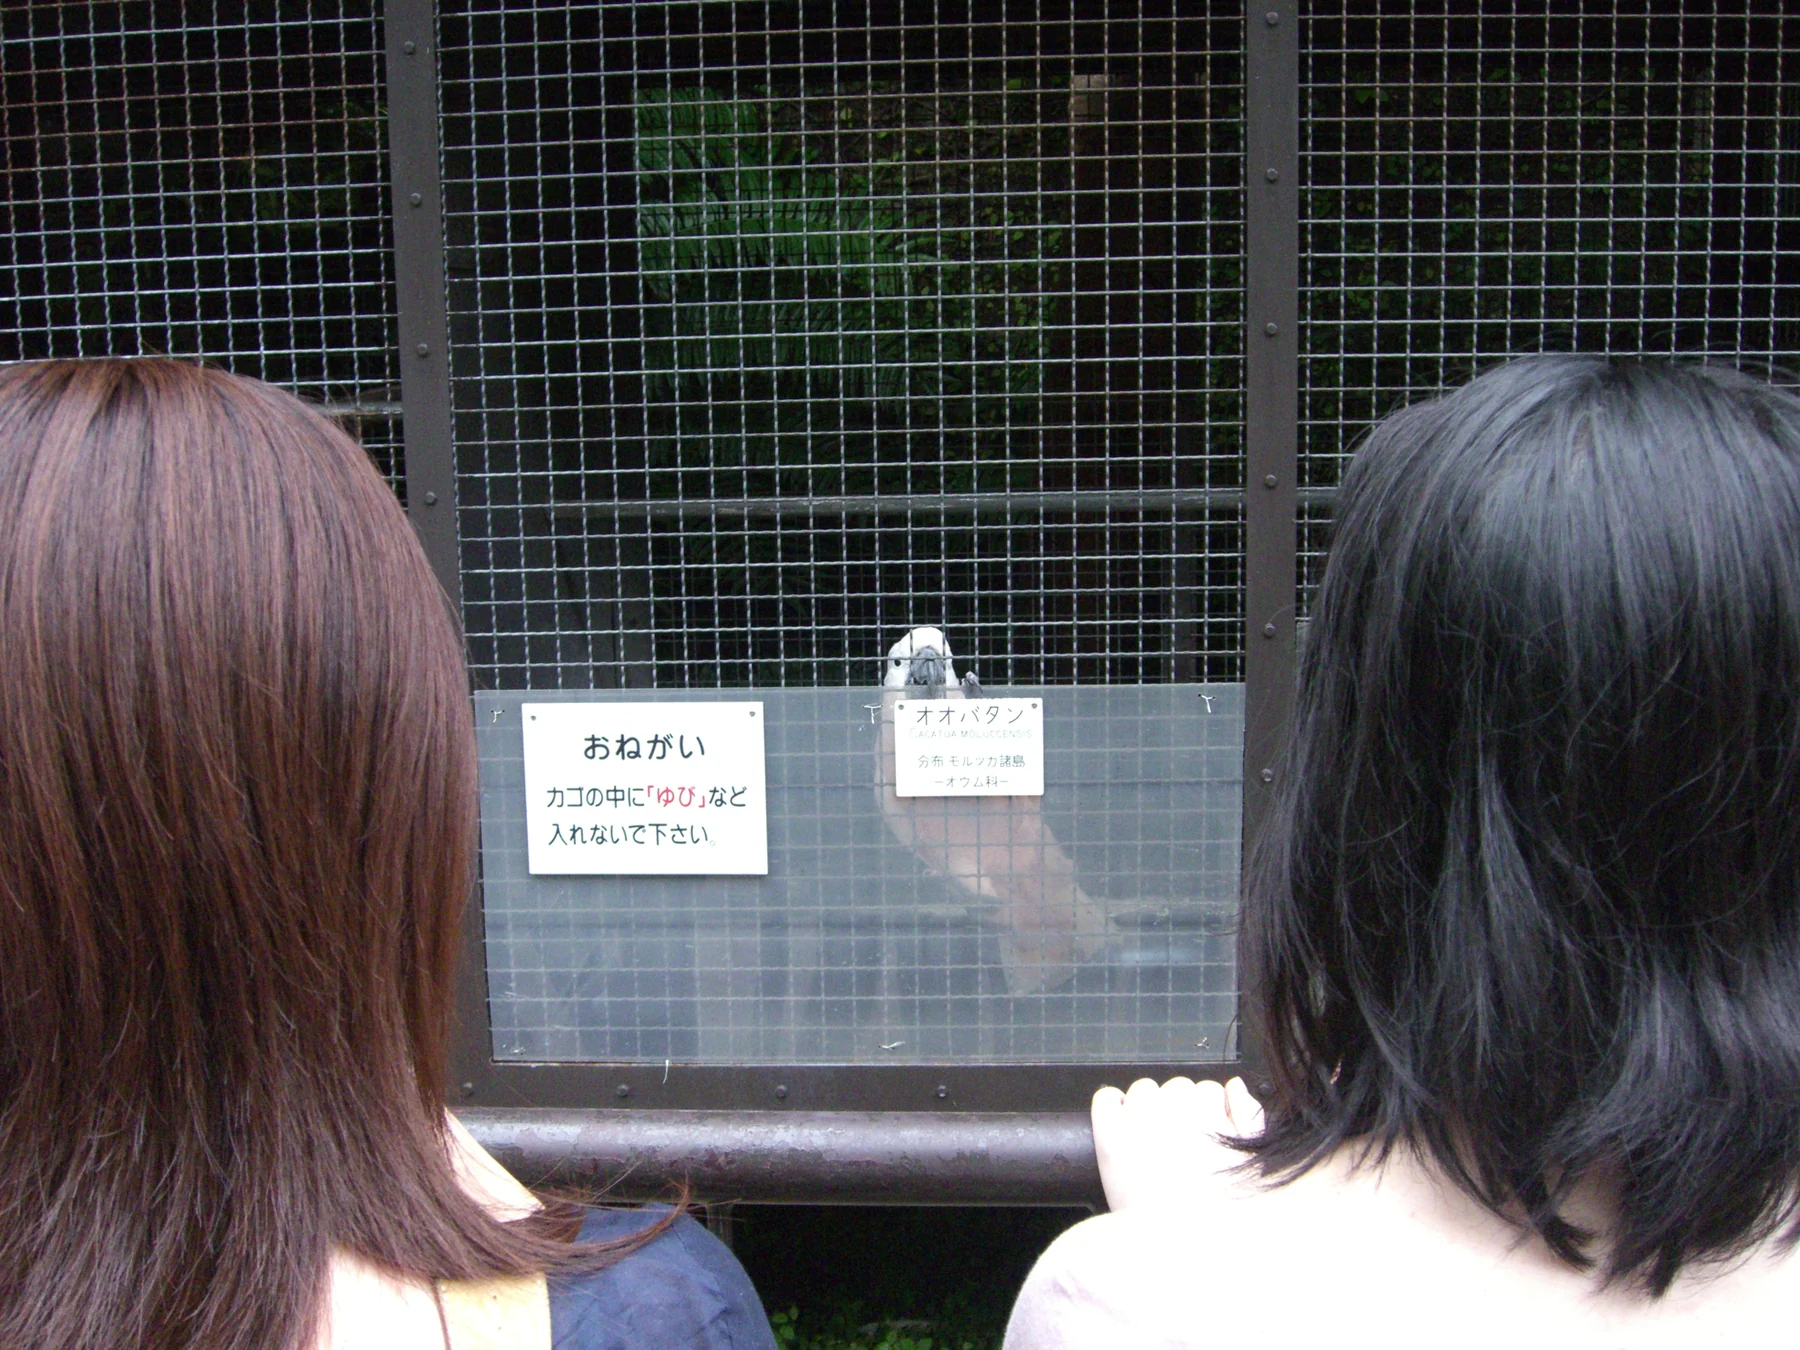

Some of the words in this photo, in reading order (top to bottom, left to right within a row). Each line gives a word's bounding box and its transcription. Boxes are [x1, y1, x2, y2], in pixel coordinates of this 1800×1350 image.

[916, 706, 1023, 726] オオバタン
[583, 733, 705, 760] おねがい
[548, 823, 716, 846] 入れないで下さい。
